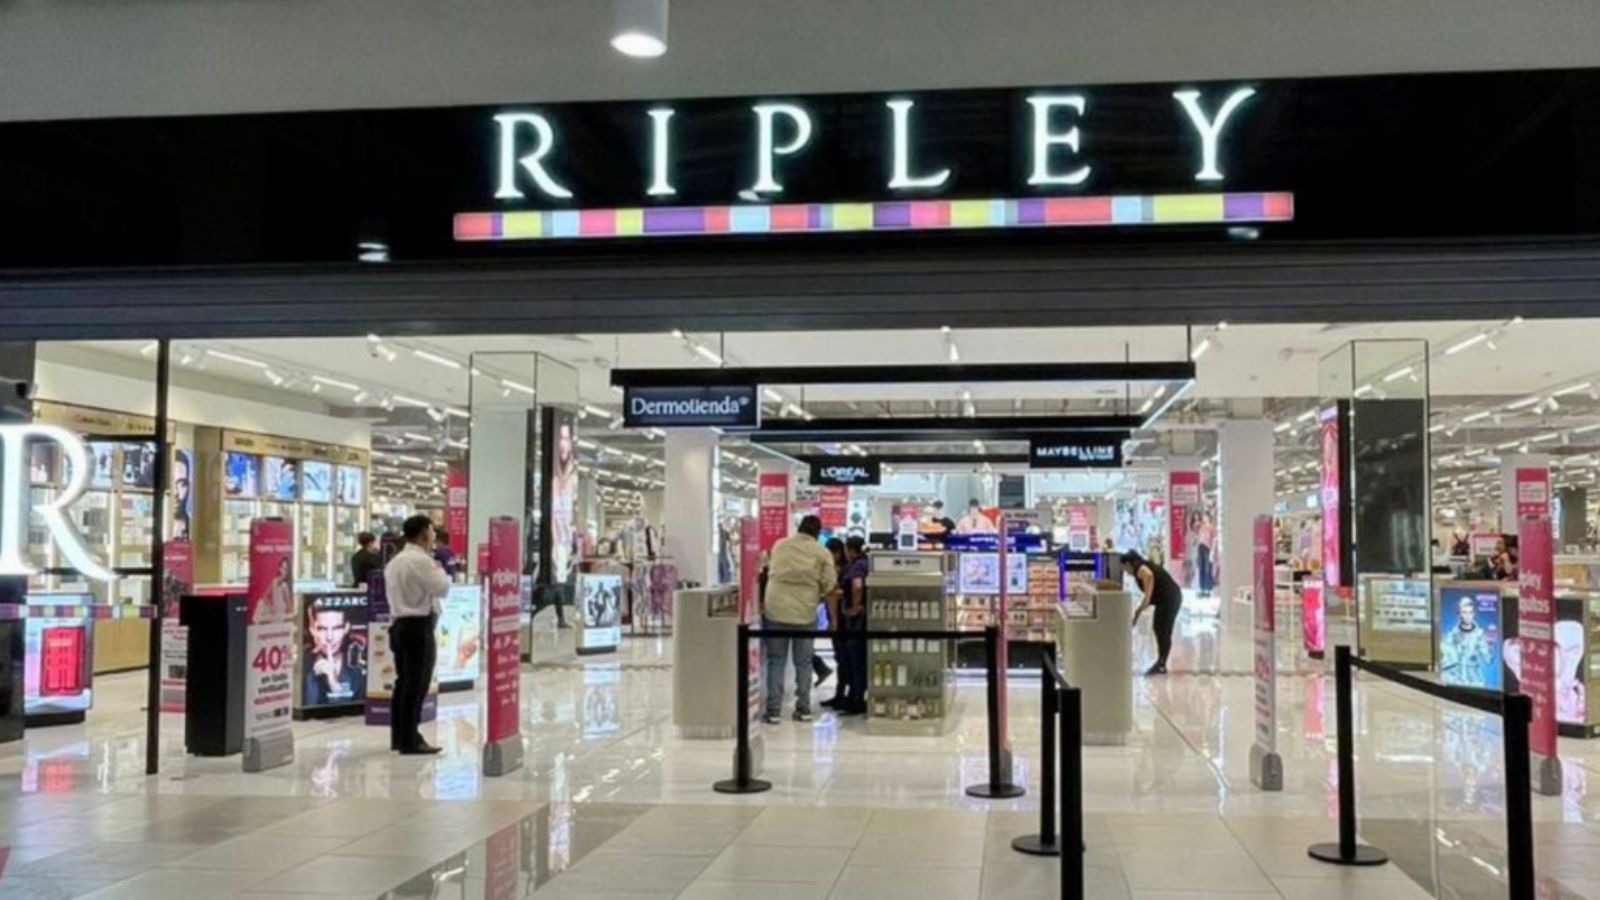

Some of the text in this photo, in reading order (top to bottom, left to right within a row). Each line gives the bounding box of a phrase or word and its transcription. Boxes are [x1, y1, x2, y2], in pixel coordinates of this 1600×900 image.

[492, 86, 1256, 200] RIPLEY
[631, 395, 739, 415] Dermotienda
[1036, 446, 1115, 458] MAYBELLINE
[0, 423, 121, 581] R
